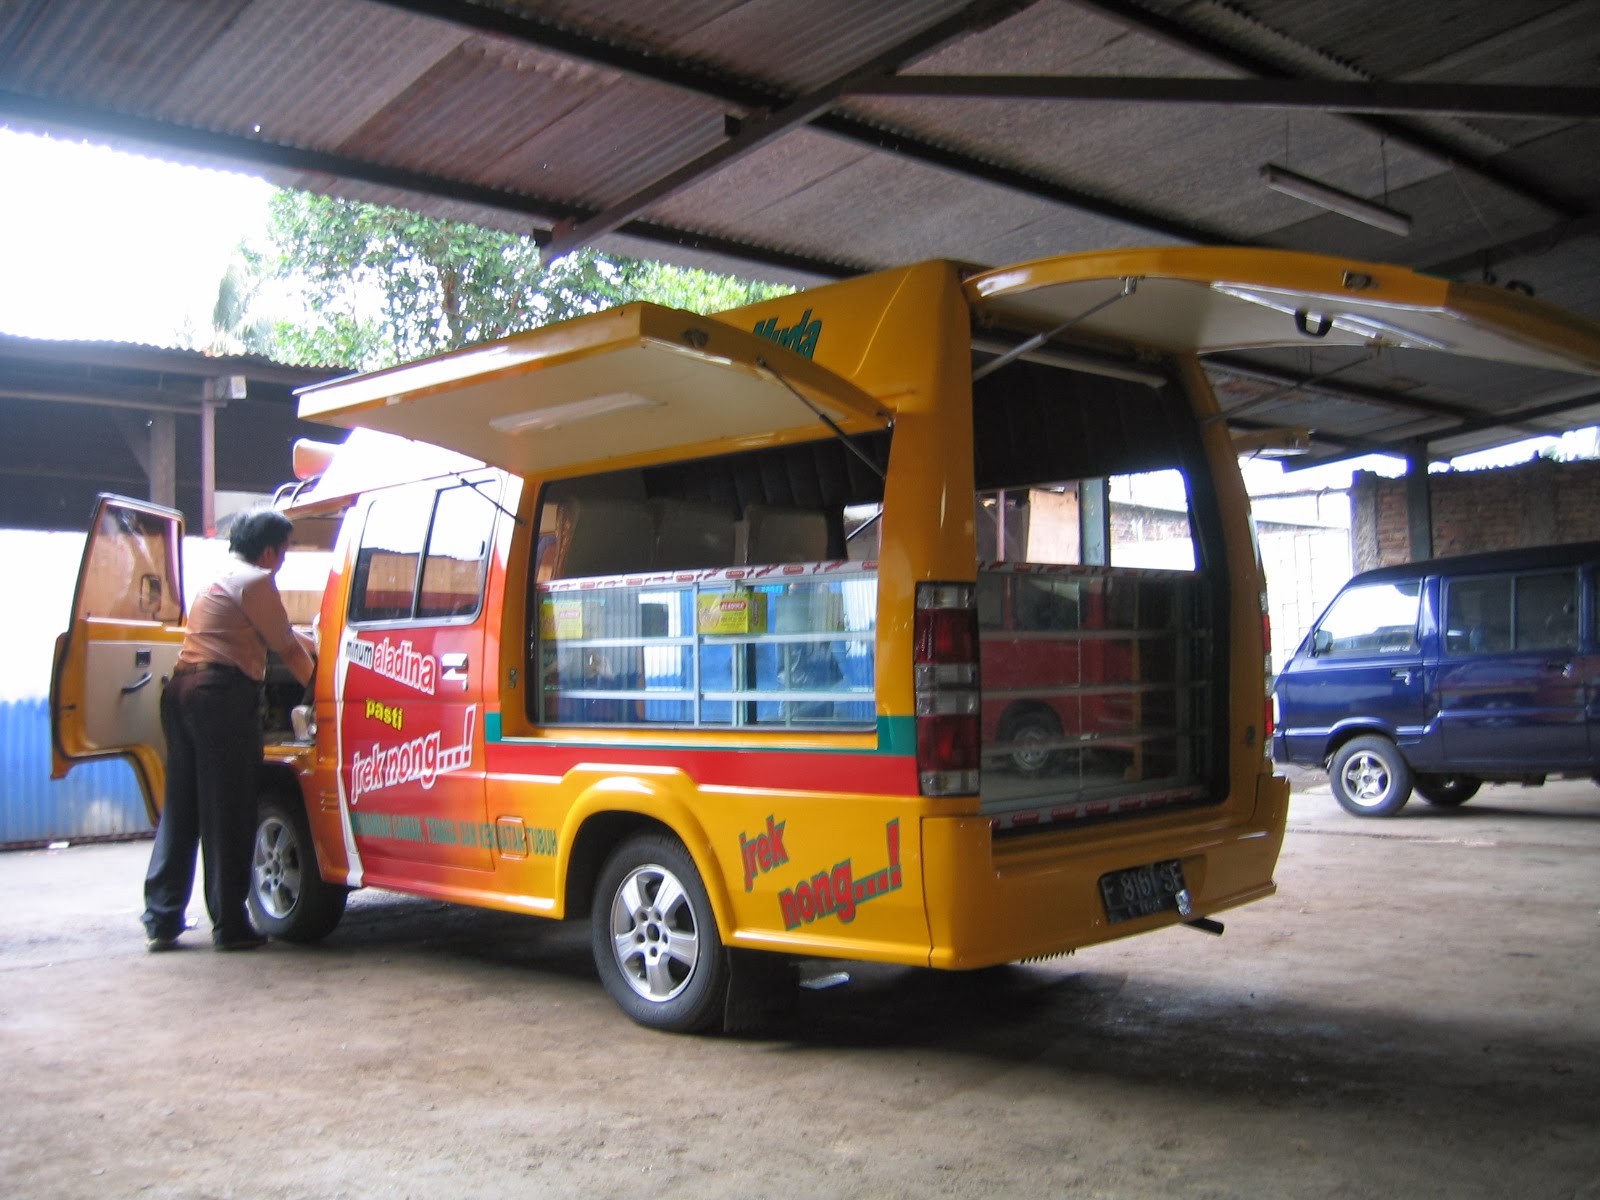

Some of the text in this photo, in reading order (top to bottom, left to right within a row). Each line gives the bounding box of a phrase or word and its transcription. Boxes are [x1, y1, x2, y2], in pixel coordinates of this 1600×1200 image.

[346, 637, 436, 695] minum aladina
[365, 696, 404, 731] pasti
[527, 827, 559, 857] TUBUH
